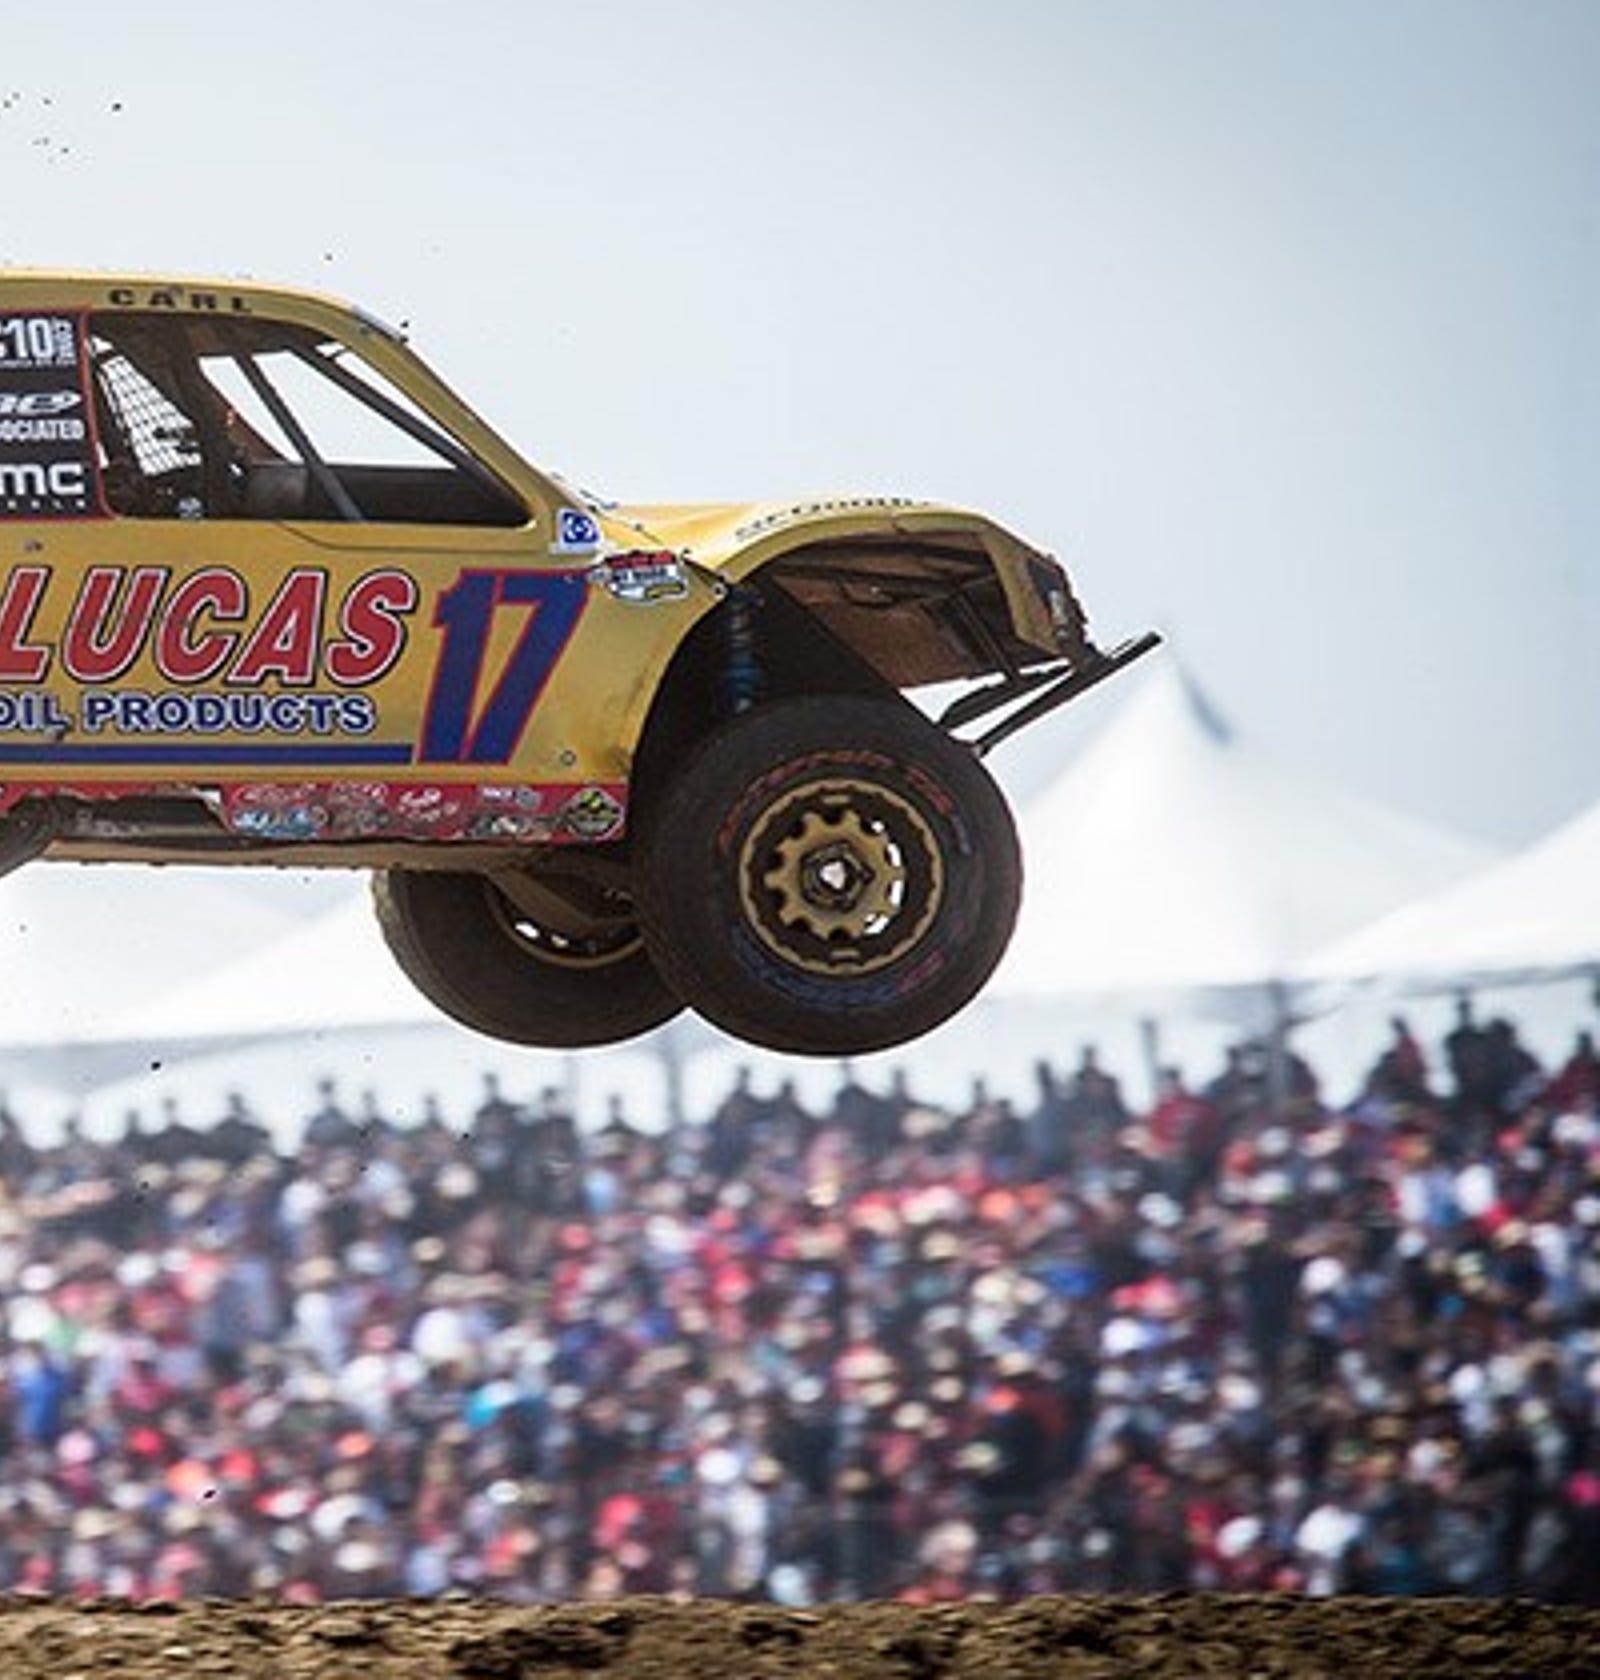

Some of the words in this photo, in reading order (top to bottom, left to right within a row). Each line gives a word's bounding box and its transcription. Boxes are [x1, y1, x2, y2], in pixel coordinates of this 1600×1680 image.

[108, 288, 253, 313] CARL
[417, 568, 596, 765] 17
[83, 692, 376, 735] PRODUCTS
